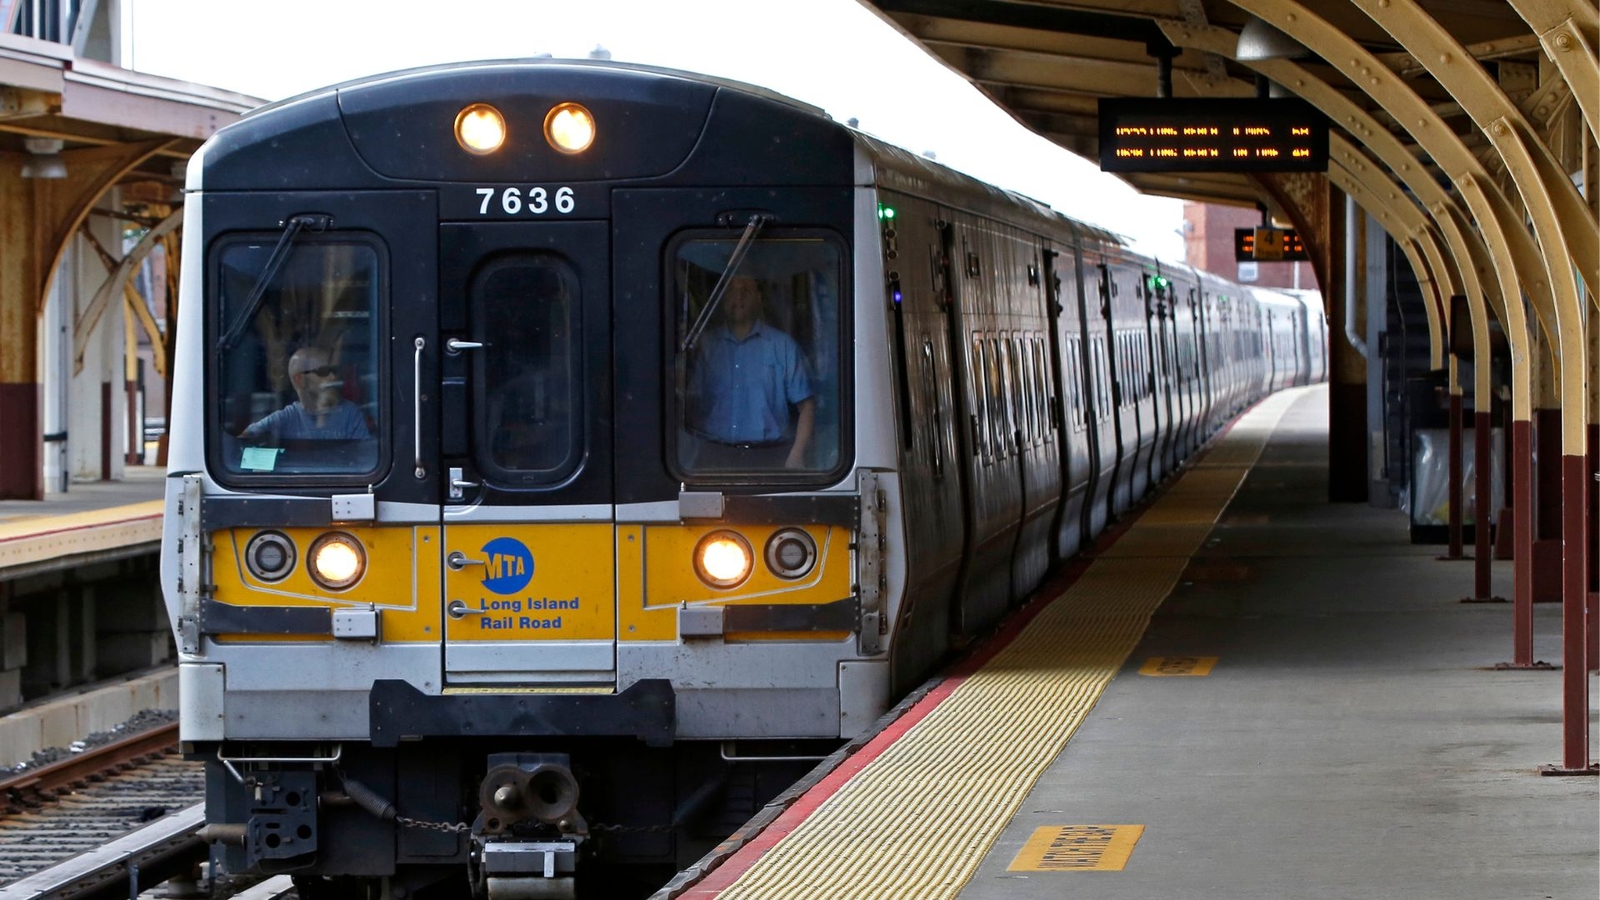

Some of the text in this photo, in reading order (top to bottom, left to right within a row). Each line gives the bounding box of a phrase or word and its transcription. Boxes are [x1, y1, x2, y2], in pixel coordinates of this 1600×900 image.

[476, 187, 575, 214] 7636
[1264, 231, 1274, 245] 4
[481, 551, 525, 581] MTA
[481, 597, 579, 612] Long Island
[481, 617, 562, 629] Rail Road
